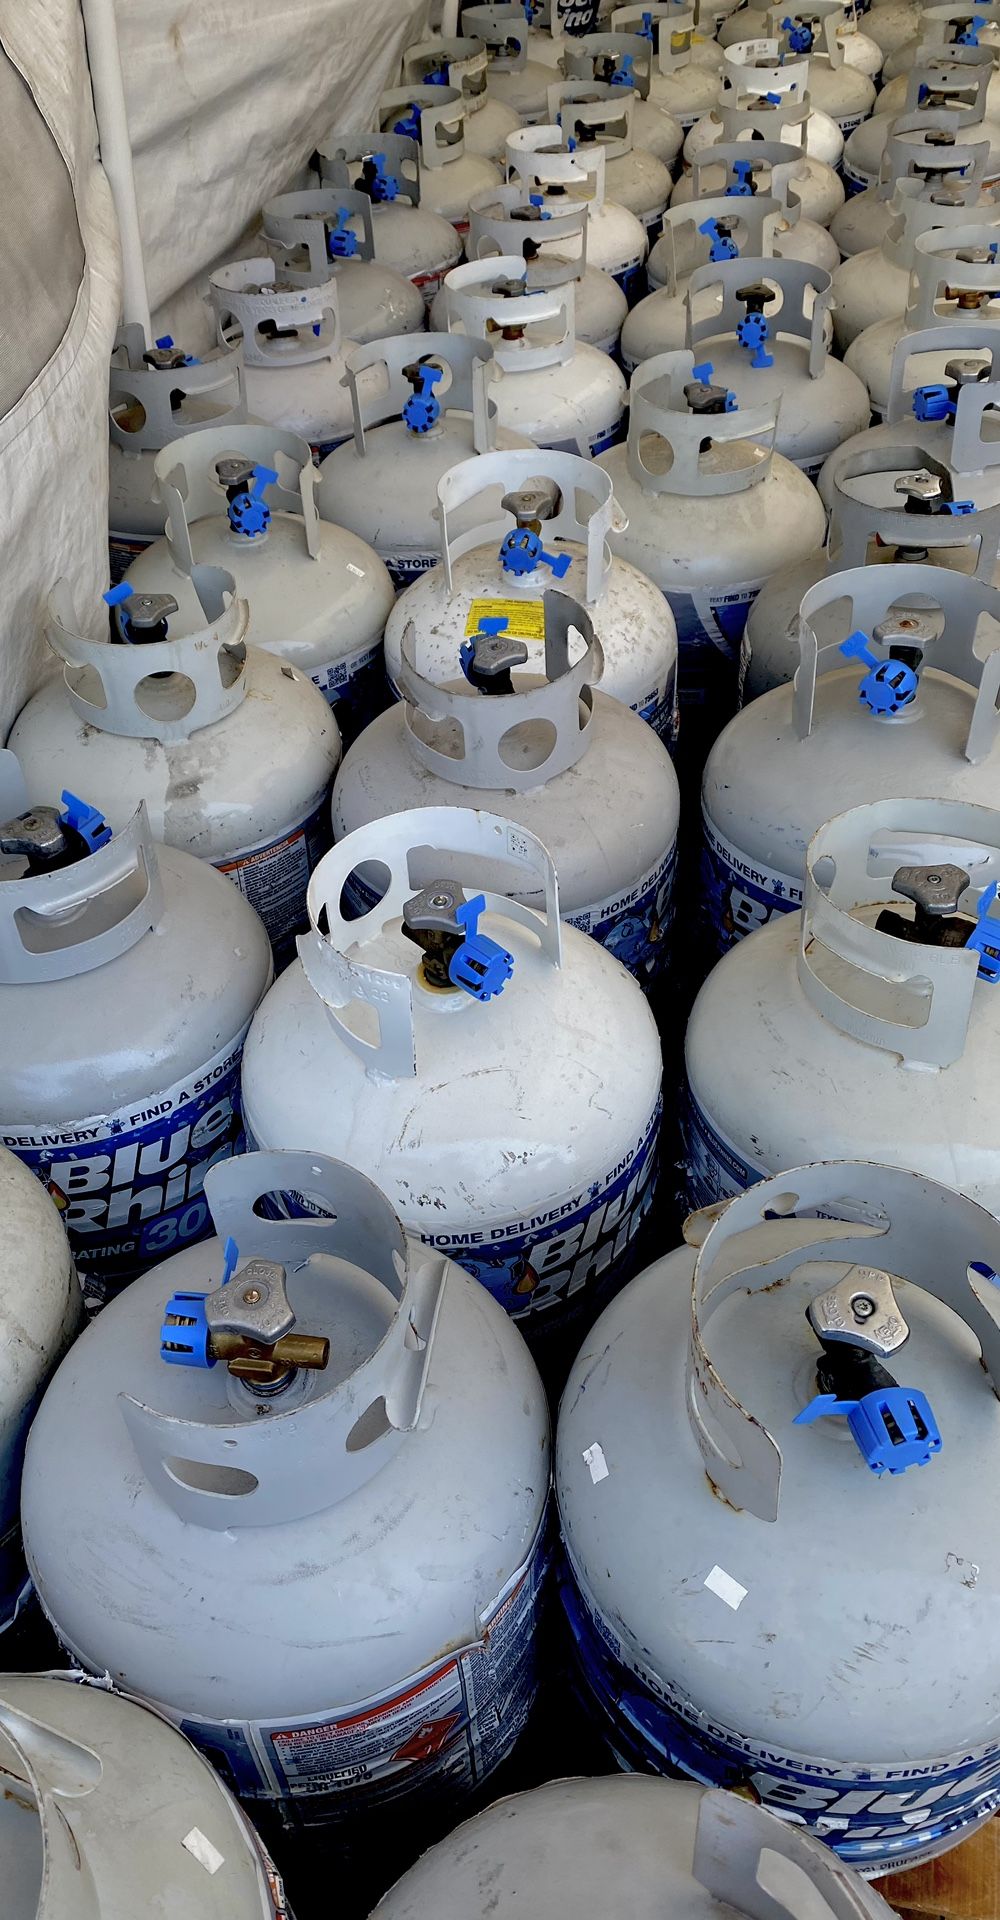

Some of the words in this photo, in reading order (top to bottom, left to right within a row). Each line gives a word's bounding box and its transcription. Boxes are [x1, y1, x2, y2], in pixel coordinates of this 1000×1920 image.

[558, 8, 593, 27] ino
[398, 559, 437, 569] STORE
[724, 593, 739, 603] FIND
[716, 841, 768, 886] DELIVERY
[789, 887, 803, 902] FI
[600, 888, 640, 919] HOME
[3, 1127, 100, 1147] DELIVERY
[129, 1100, 173, 1127] FIND
[178, 1090, 191, 1104] A
[193, 1047, 242, 1094] STORE
[49, 1096, 233, 1196] Blue
[420, 1231, 484, 1248] HOME
[490, 1195, 583, 1240] DELIVERY
[605, 1150, 634, 1186] FIND
[637, 1137, 644, 1151] A
[145, 1201, 208, 1250] 30
[291, 1724, 338, 1738] DANGER
[633, 1662, 700, 1724] HOME
[707, 1724, 842, 1777] DELIVERY
[886, 1763, 950, 1779] FIND
[958, 1755, 975, 1766] A
[750, 1759, 1000, 1815] Blue
